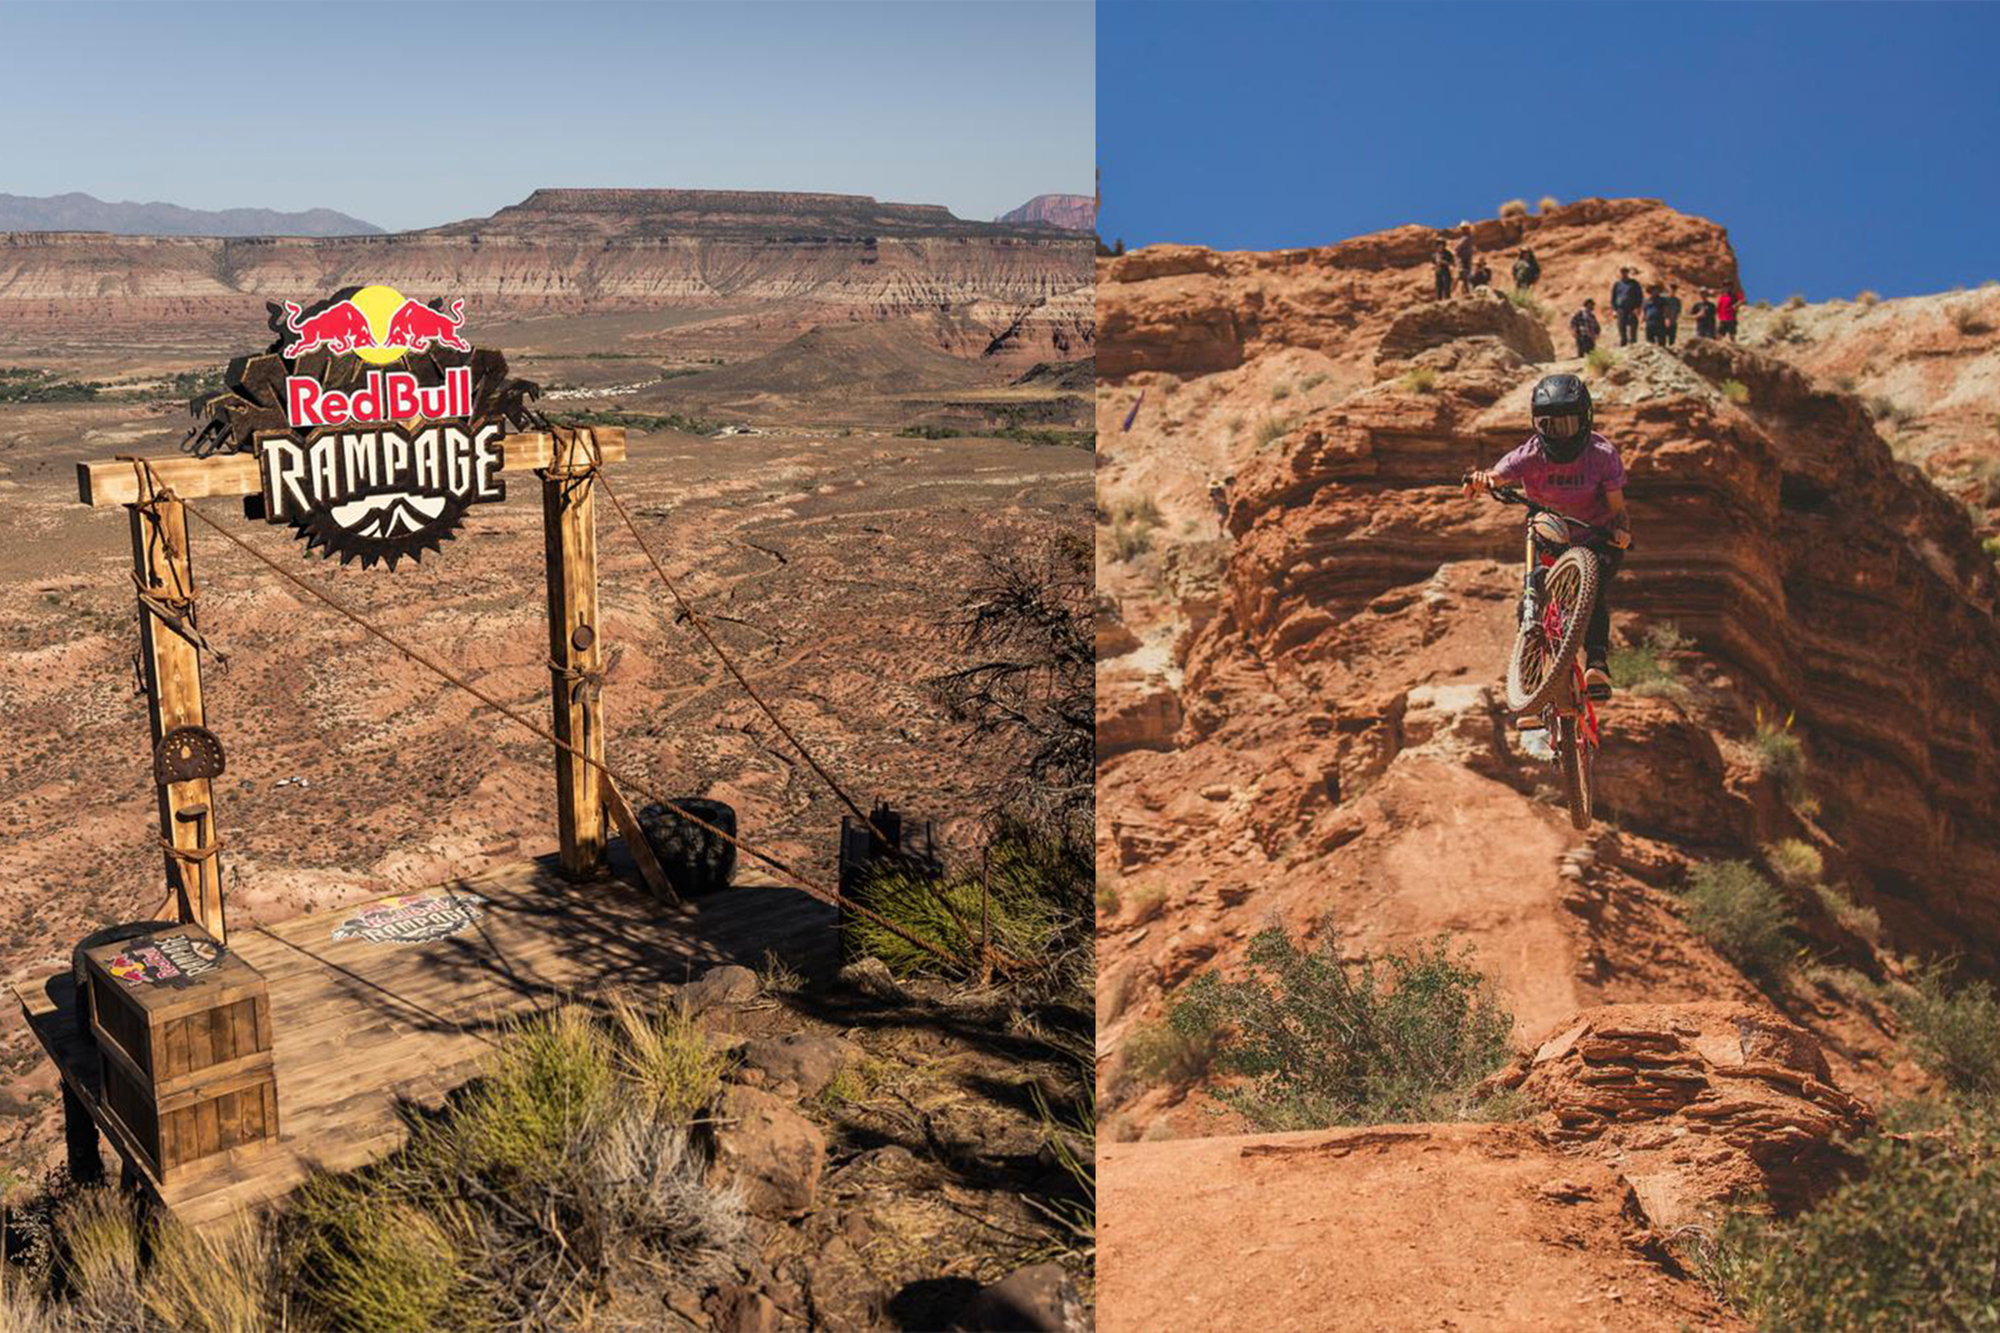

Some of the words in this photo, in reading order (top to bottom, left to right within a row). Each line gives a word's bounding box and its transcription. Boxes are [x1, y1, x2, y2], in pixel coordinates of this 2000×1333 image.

[286, 370, 382, 427] Red
[385, 366, 472, 421] Bull
[262, 425, 499, 516] RAMPAGE
